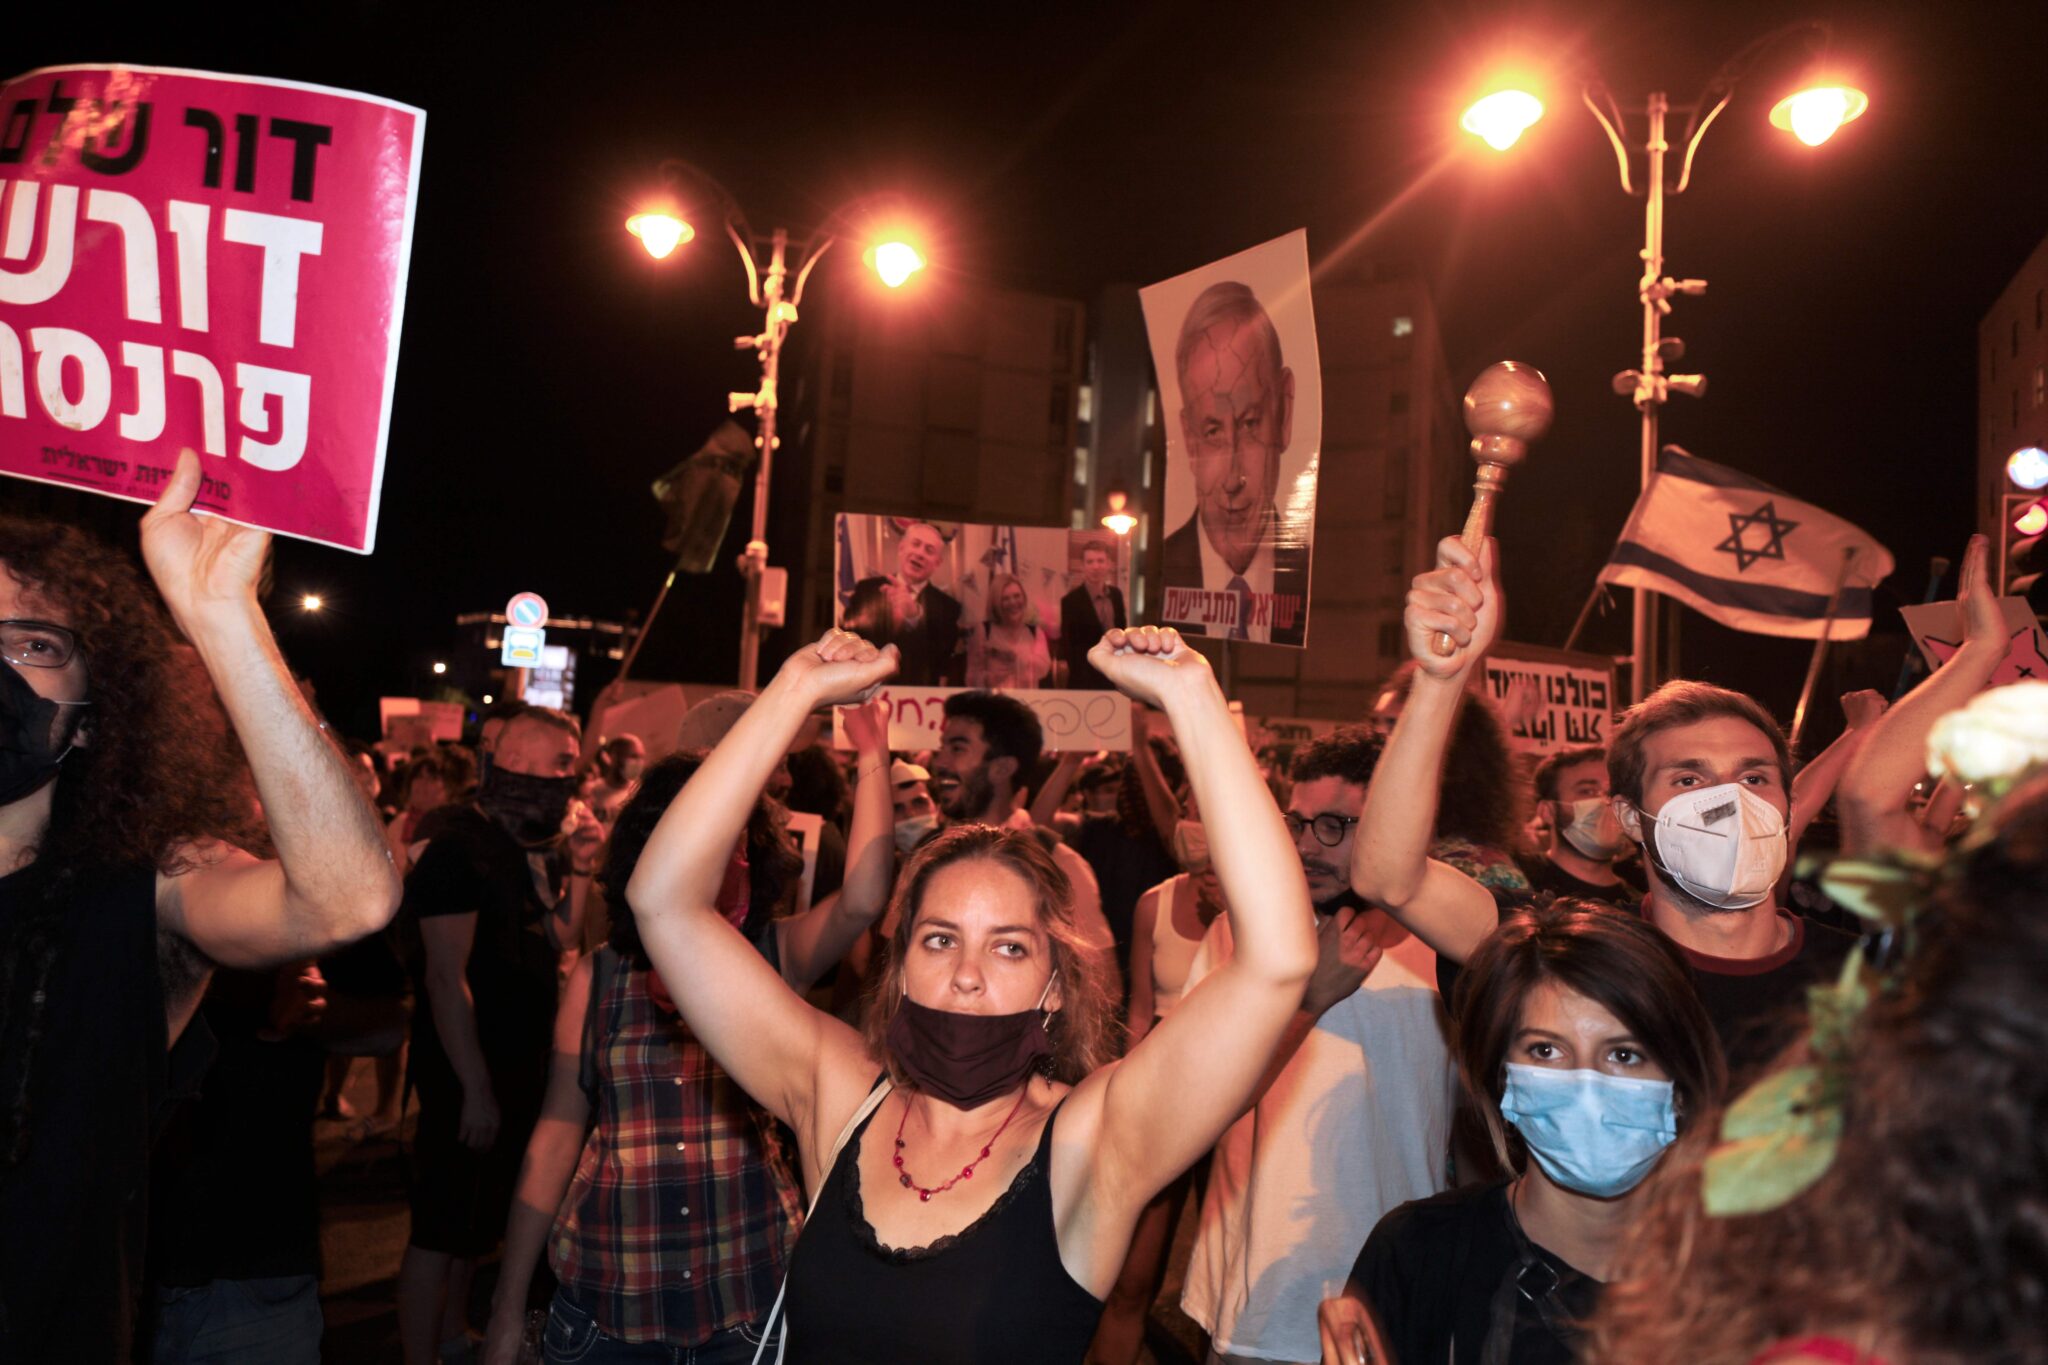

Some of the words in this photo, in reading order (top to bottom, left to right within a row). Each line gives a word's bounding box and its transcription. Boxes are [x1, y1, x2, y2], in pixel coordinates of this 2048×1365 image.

[184, 106, 333, 204] דור
[0, 177, 324, 348] דורש
[41, 446, 128, 477] ישראלית
[1165, 588, 1237, 625] מתביישת
[1247, 592, 1301, 630] ישראל
